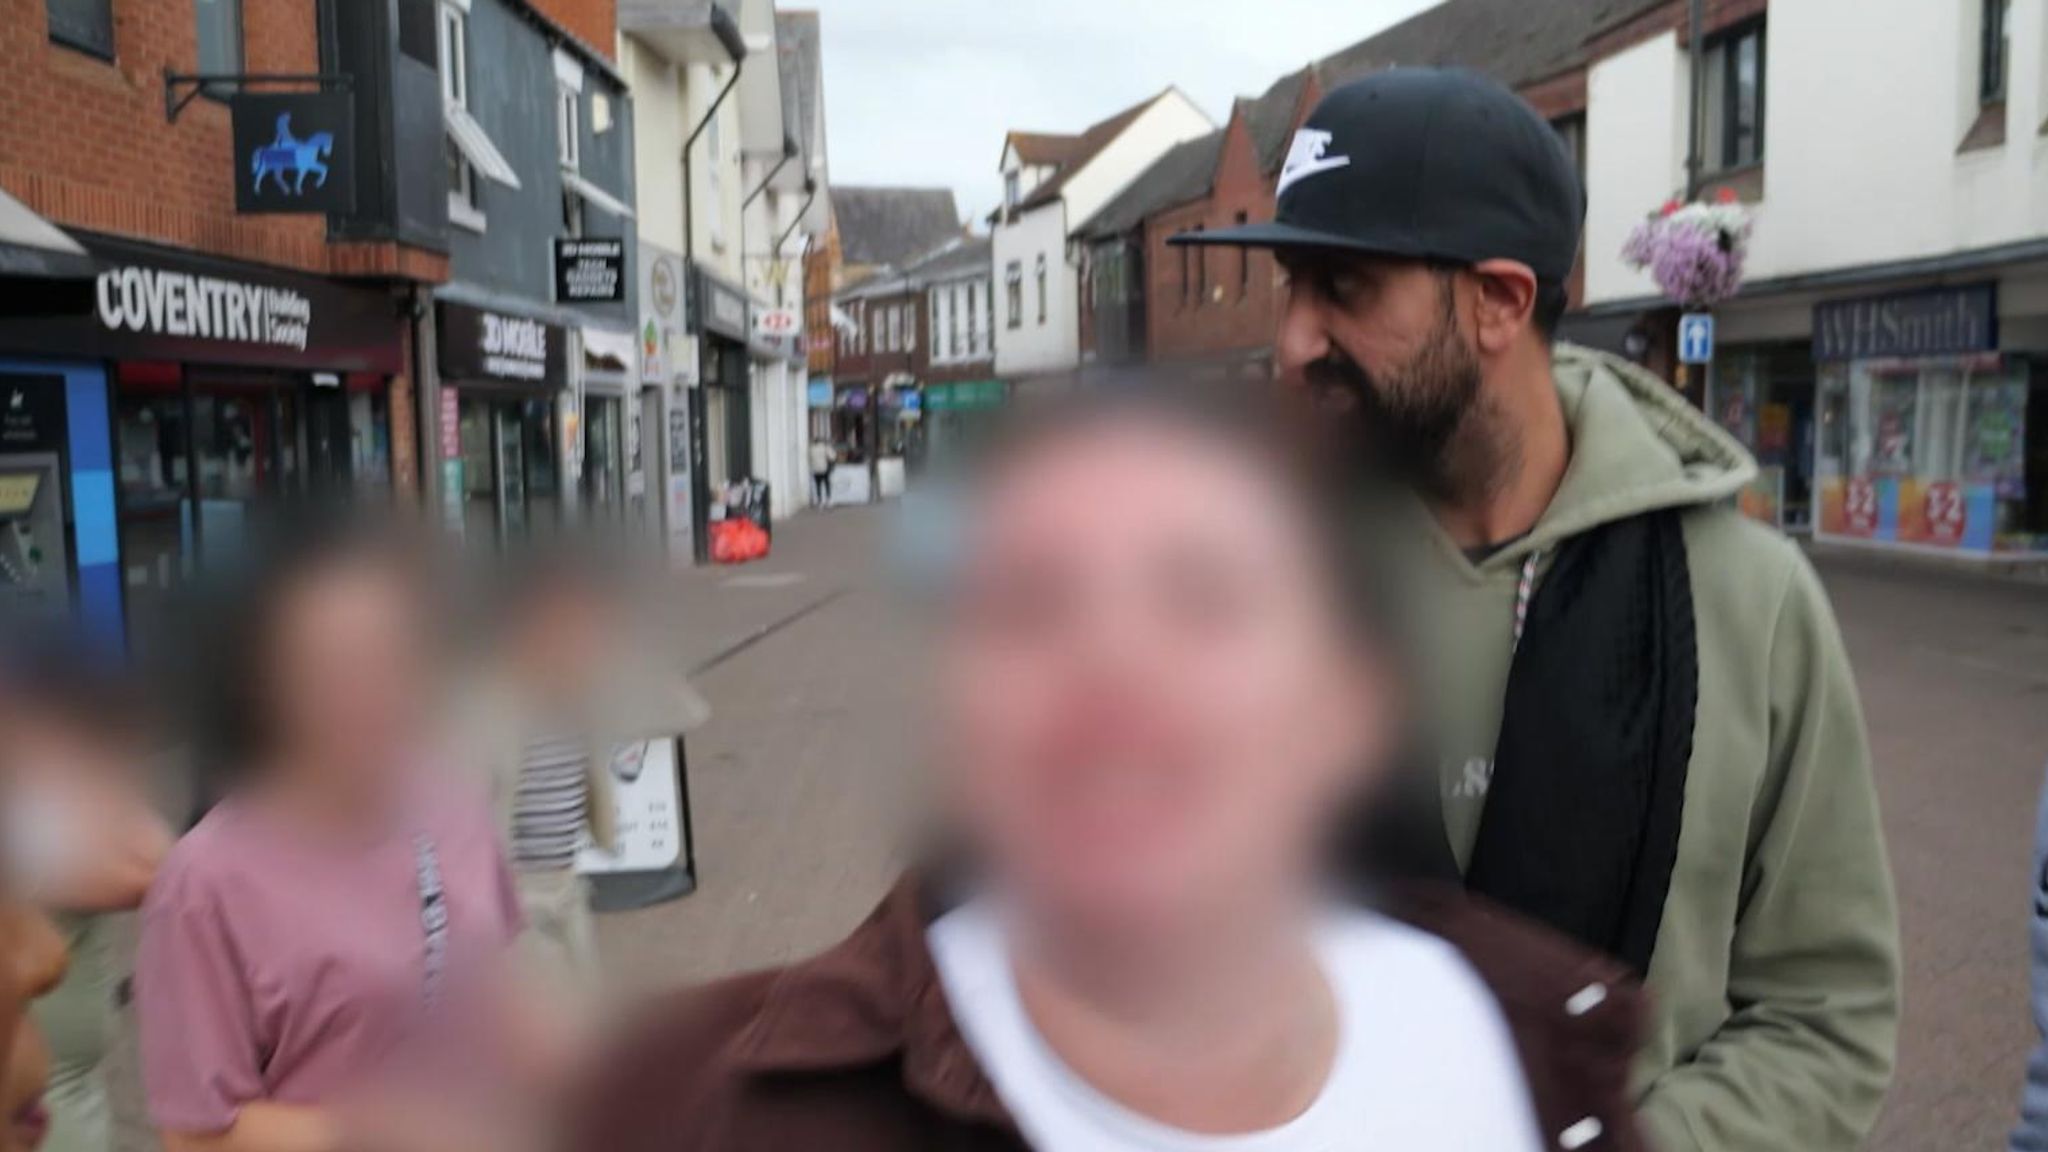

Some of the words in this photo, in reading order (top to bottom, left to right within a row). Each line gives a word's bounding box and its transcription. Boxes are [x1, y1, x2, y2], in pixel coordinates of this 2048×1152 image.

[97, 266, 262, 343] COVENTRY
[1820, 290, 1978, 356] WHSmith
[502, 317, 547, 361] MOBILE
